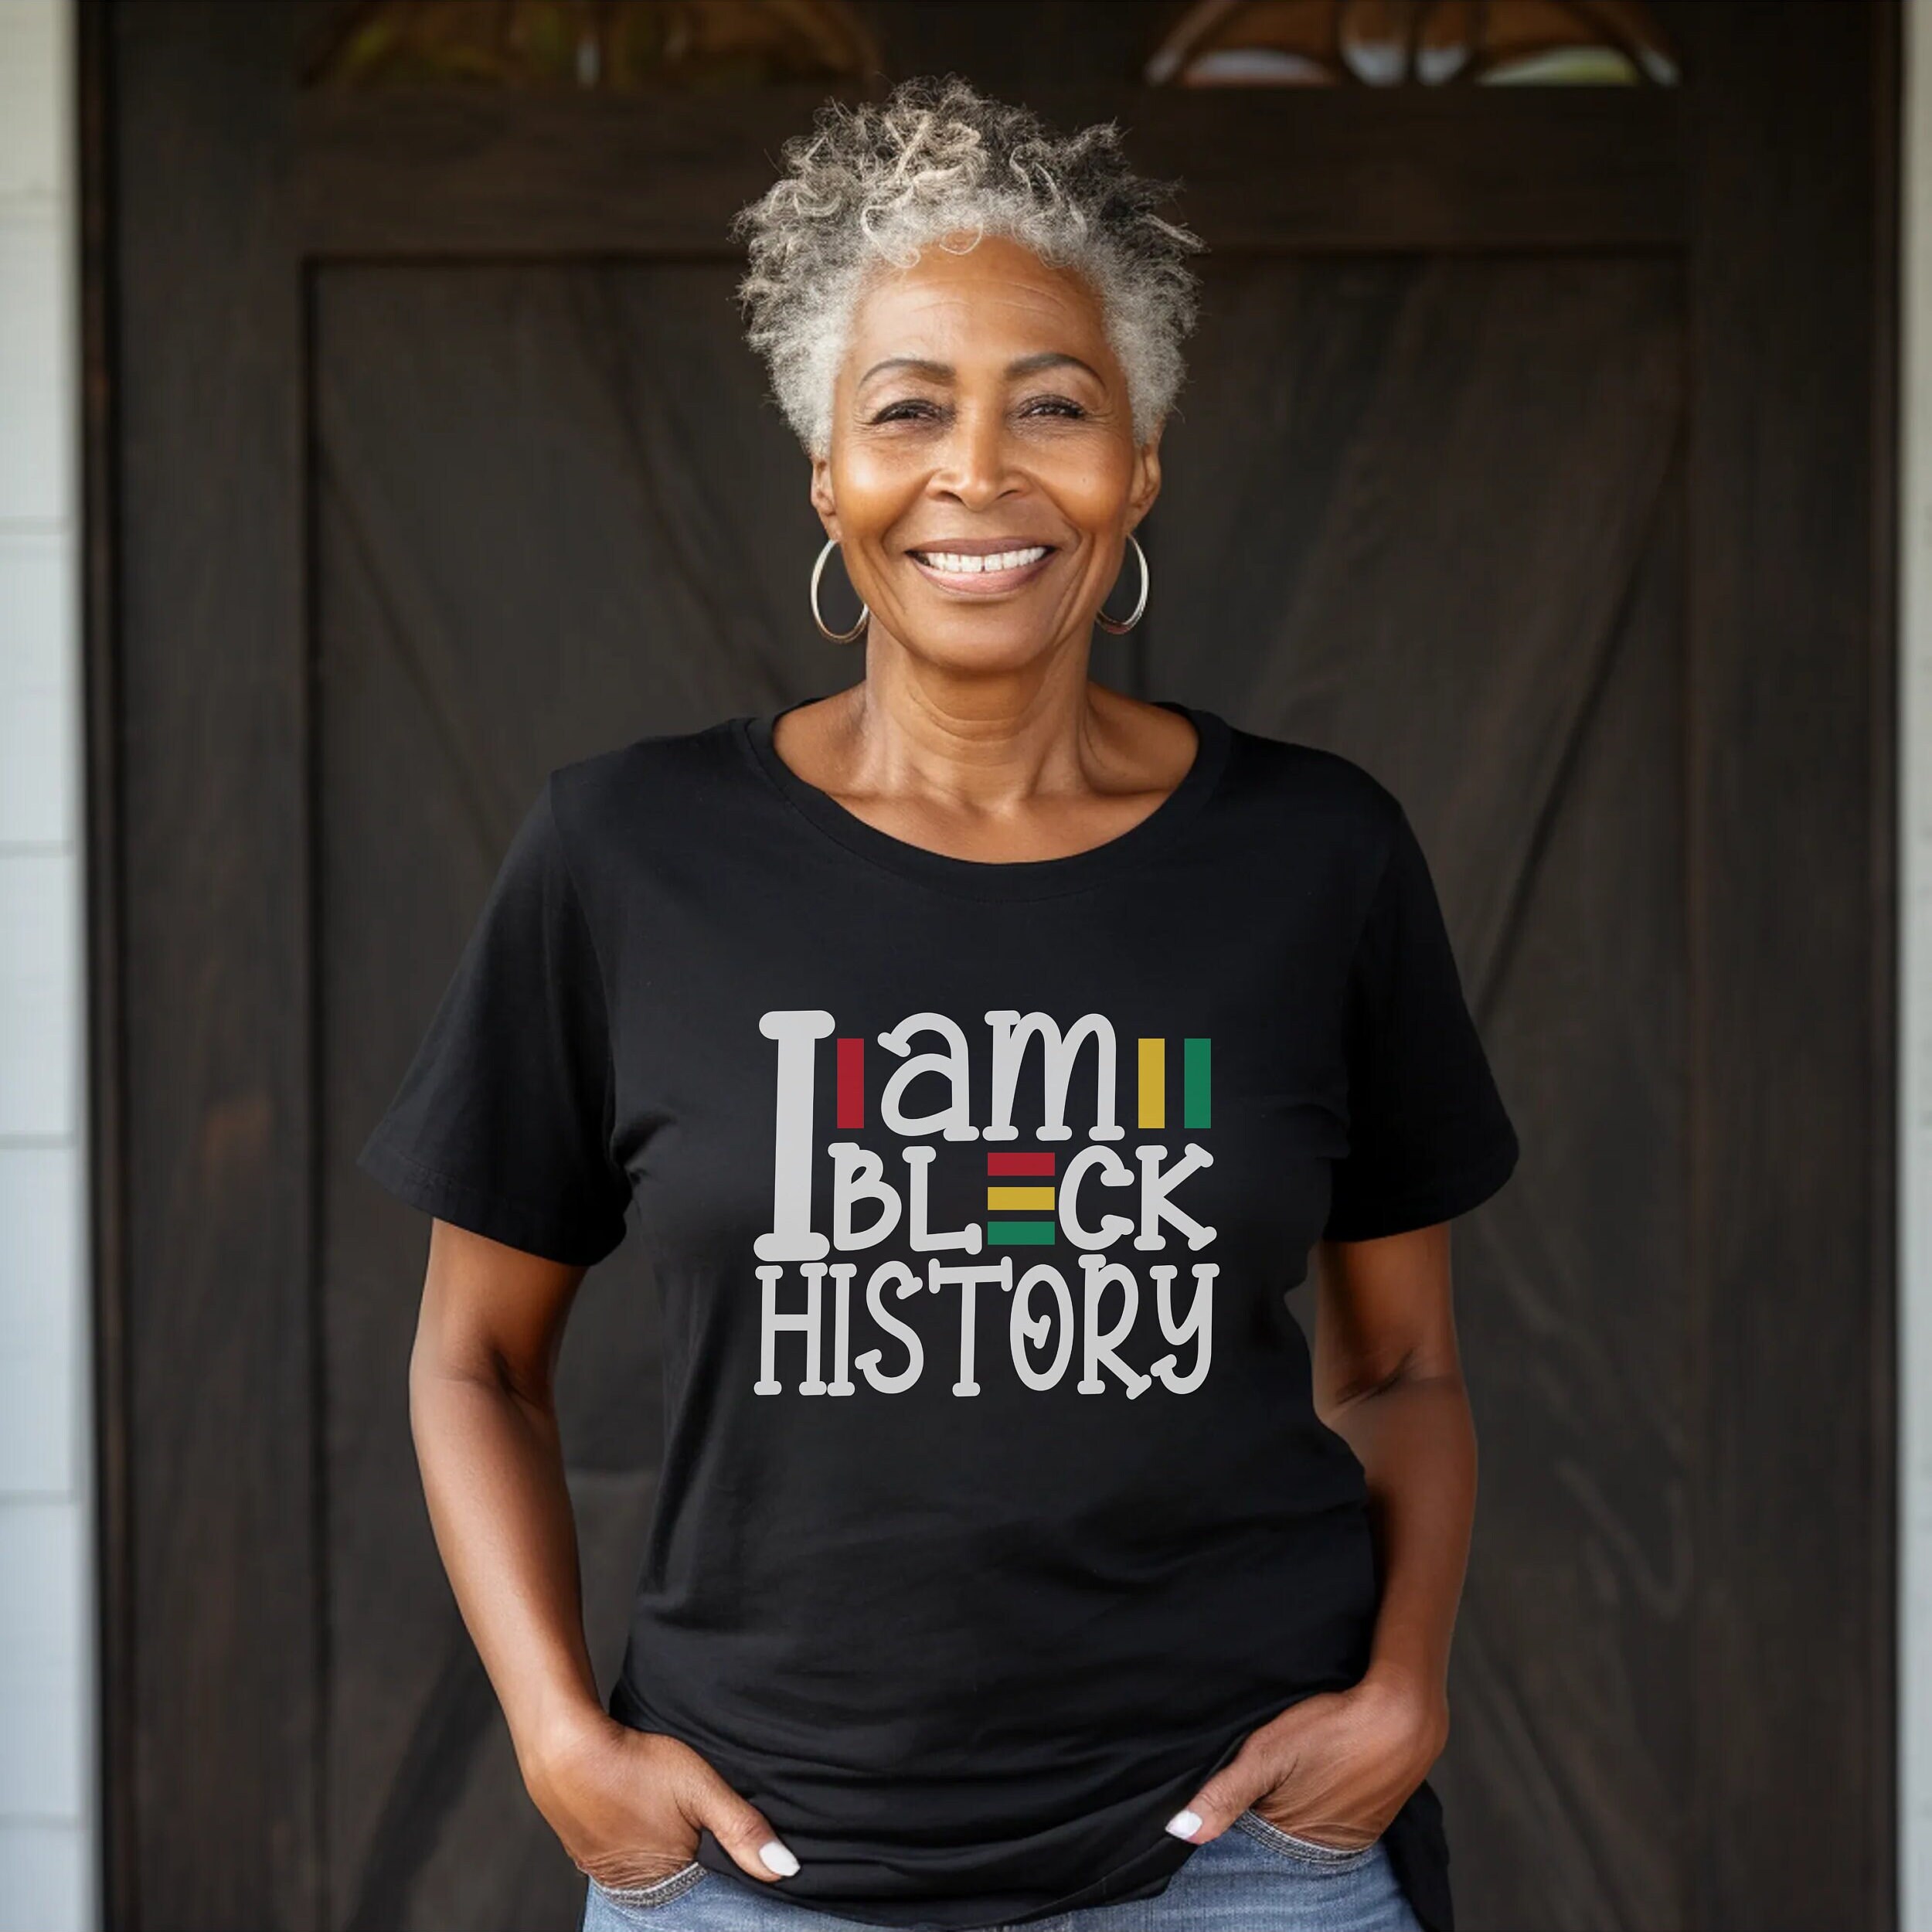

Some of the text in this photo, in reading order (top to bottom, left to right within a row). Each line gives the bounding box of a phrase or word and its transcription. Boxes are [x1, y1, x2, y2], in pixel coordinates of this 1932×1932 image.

[753, 1009, 1125, 1262] I am
[753, 1253, 1220, 1400] HISTORY
